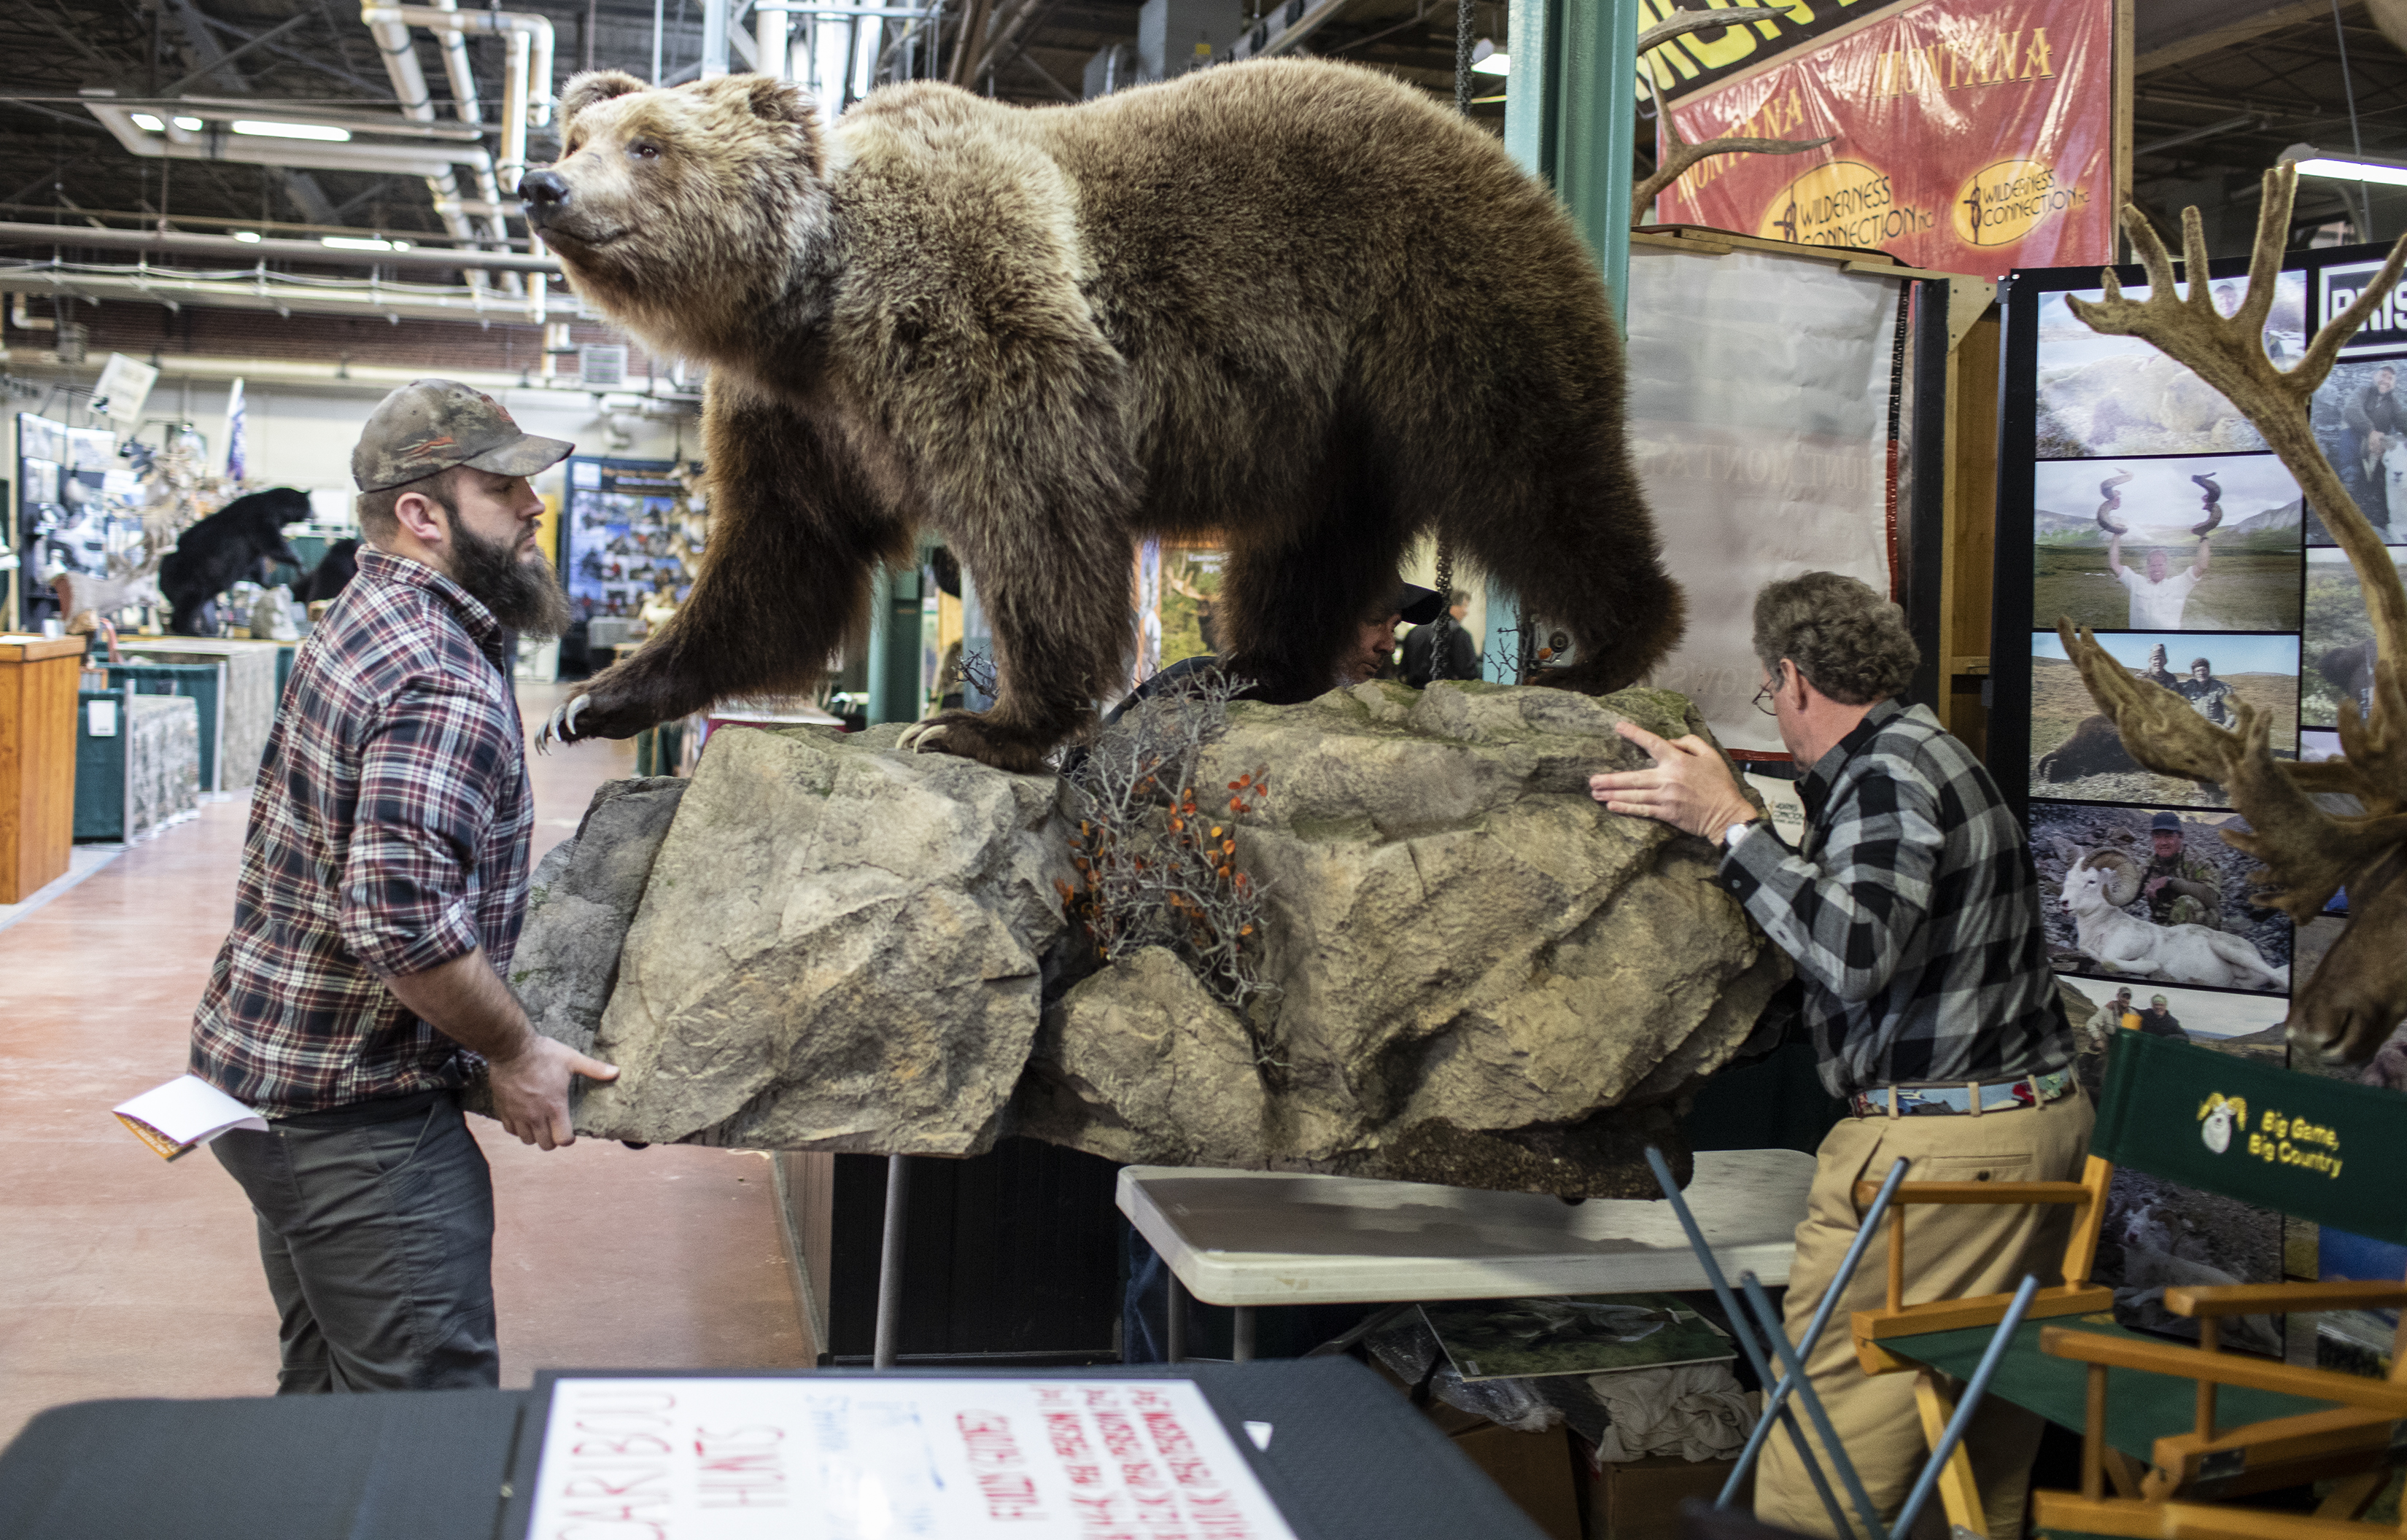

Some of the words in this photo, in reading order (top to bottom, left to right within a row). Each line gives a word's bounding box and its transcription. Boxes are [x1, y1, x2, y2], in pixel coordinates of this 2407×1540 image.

[1875, 27, 2056, 101] MONTANA
[1799, 176, 1892, 228] WILDERNESS
[1982, 168, 2055, 204] WILDERNESS
[1982, 187, 2079, 227] CONNECTION
[2261, 1110, 2290, 1138] Big
[2291, 1116, 2340, 1151] Game,
[2248, 1132, 2275, 1163] Big
[2278, 1140, 2343, 1180] Country
[556, 1389, 678, 1540] CARIBOU
[693, 1424, 789, 1509] HUNTS
